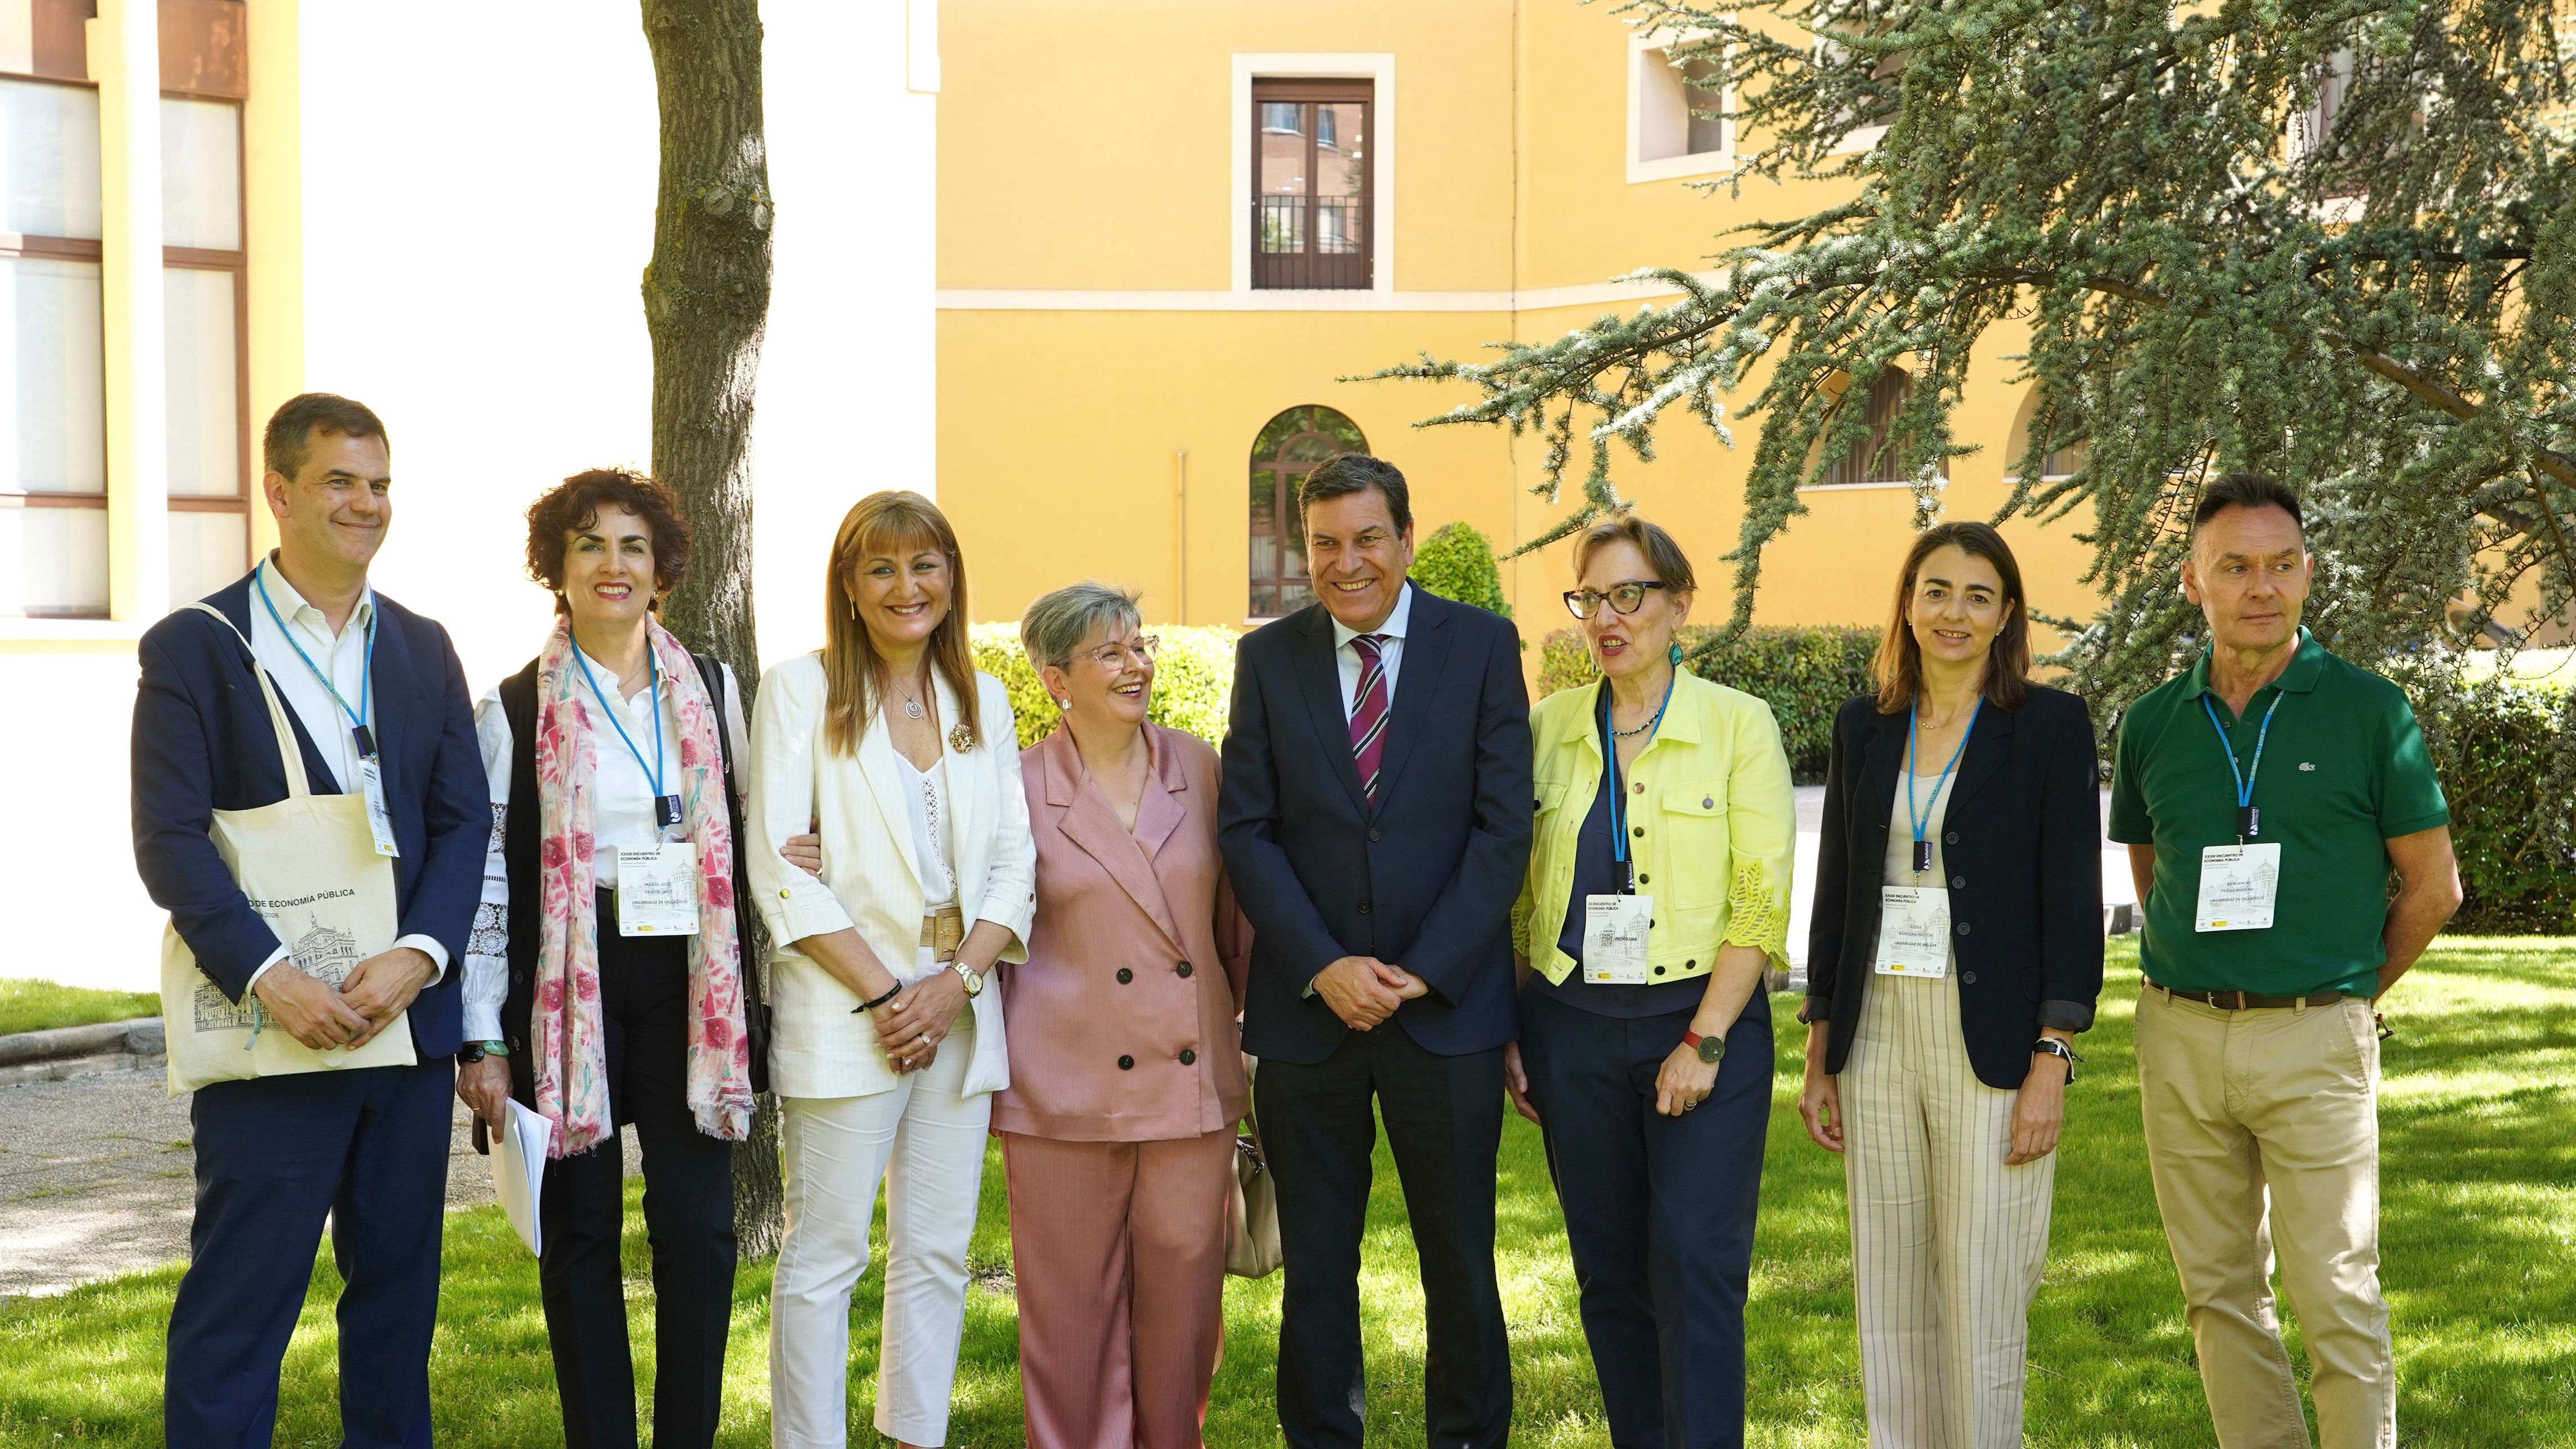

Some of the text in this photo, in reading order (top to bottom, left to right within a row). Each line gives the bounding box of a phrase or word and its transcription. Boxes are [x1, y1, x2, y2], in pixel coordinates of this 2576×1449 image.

[2250, 728, 2266, 781] TURISMO VALLADOLID
[269, 895, 315, 907] ECONOMÍA
[317, 889, 355, 900] PÚBLICA
